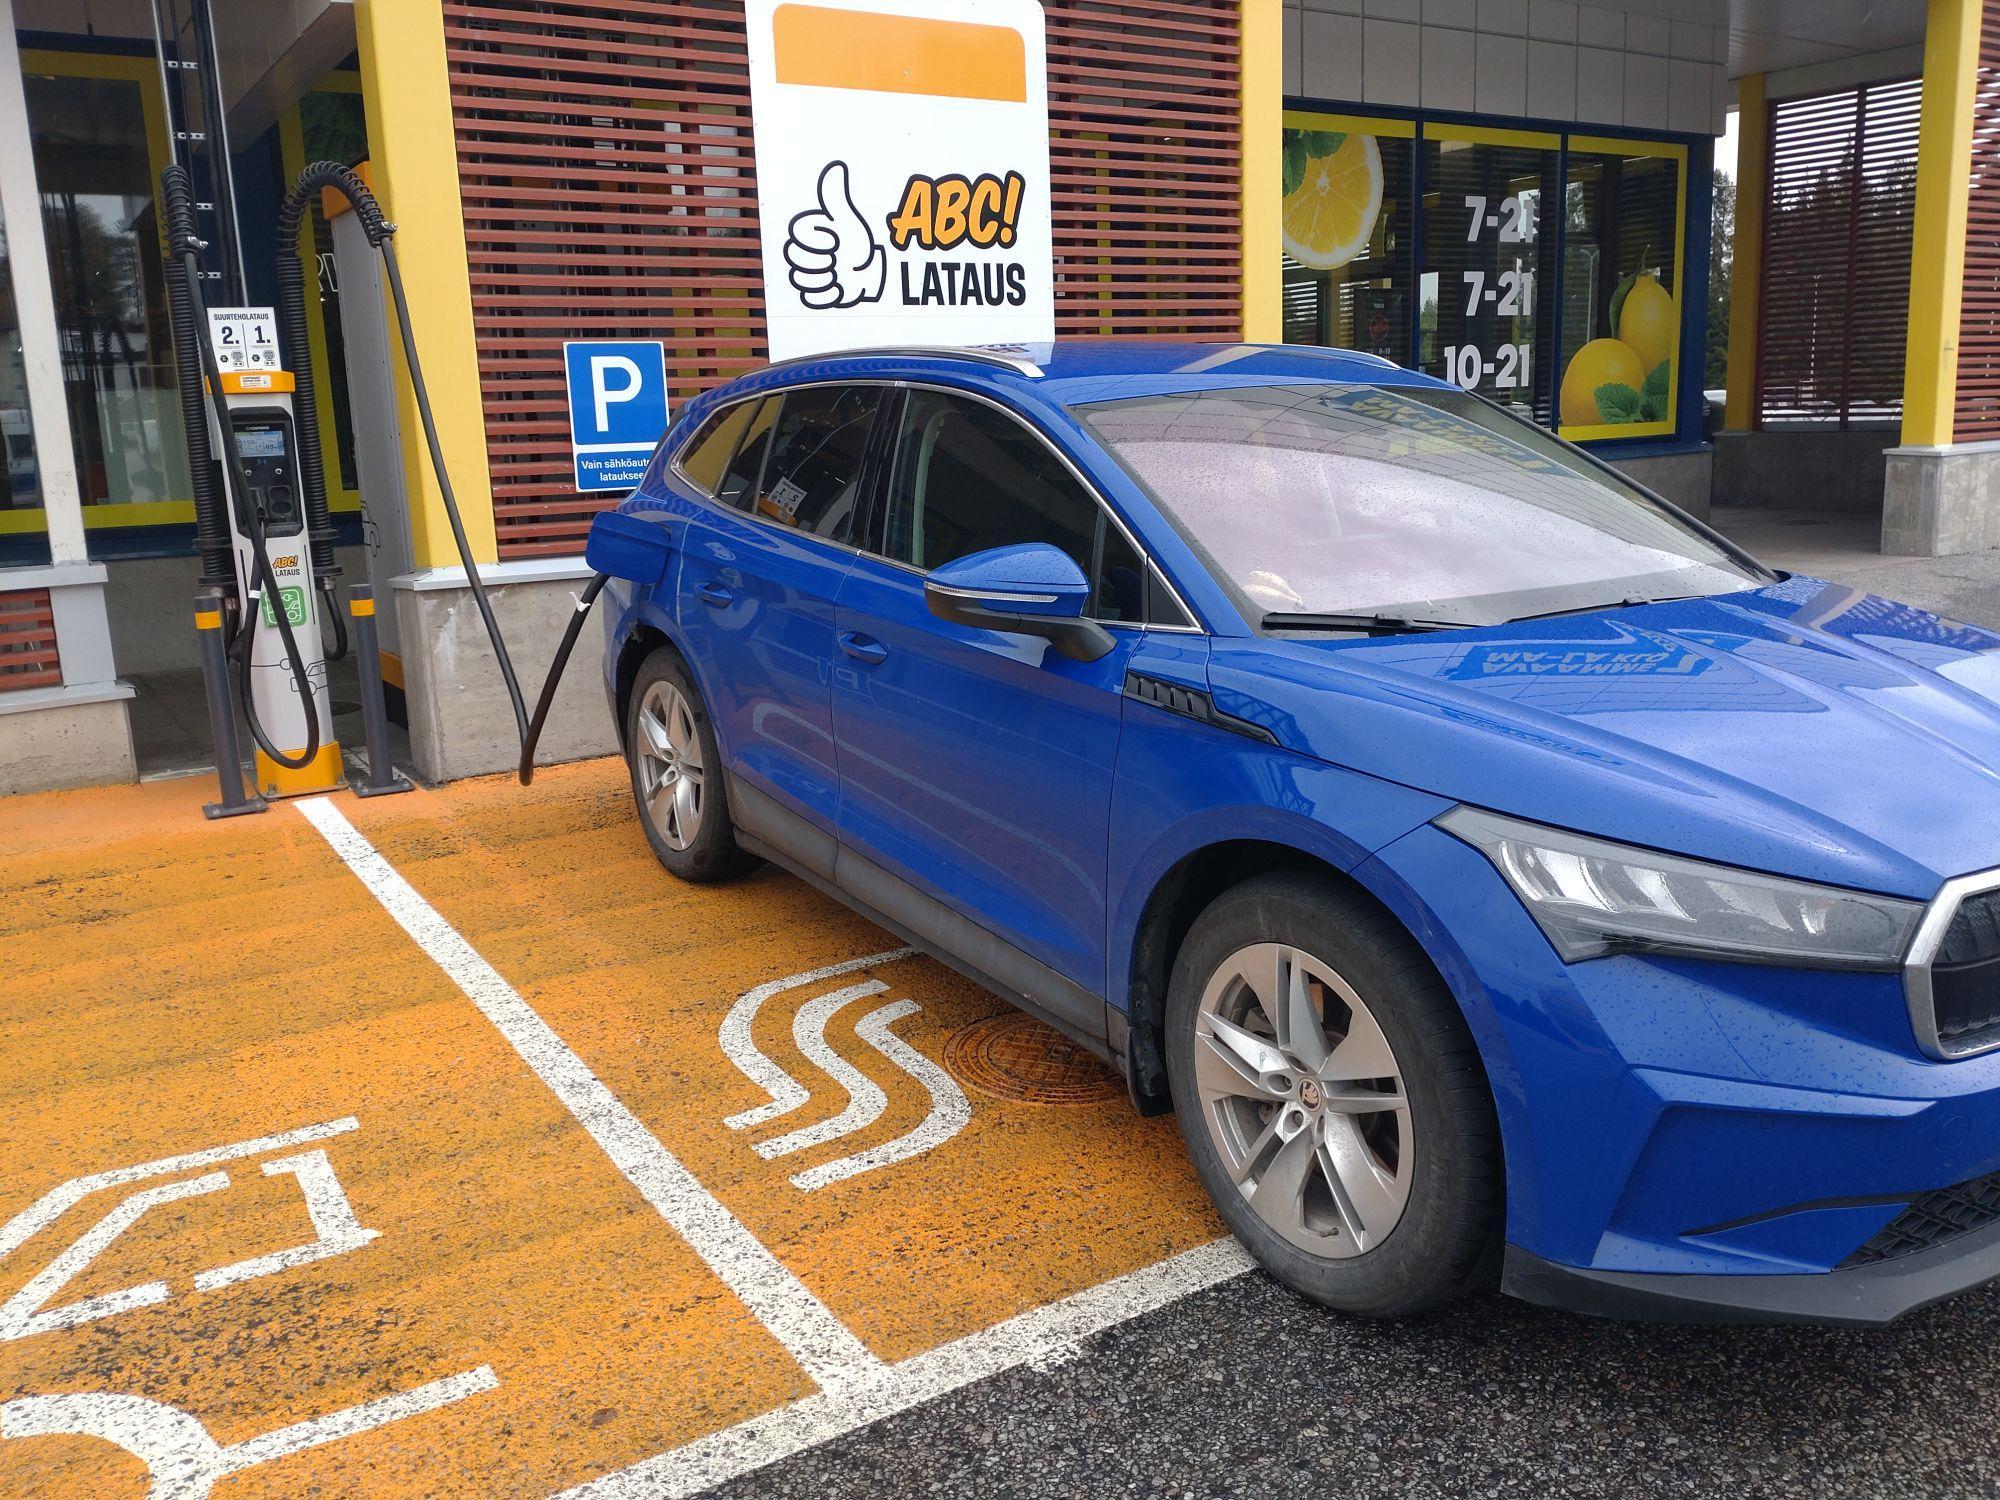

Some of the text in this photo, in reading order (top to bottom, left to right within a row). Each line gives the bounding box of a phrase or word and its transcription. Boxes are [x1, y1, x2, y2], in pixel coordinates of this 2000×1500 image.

[886, 169, 1026, 251] ABC!
[1465, 196, 1534, 243] 7-21
[900, 261, 1027, 307] LATAUS
[1463, 271, 1532, 317] 7-21
[213, 313, 270, 321] SUURTEHOLATAUS
[1444, 343, 1531, 391] 10-21
[590, 355, 643, 433] P
[581, 460, 603, 471] Vain
[272, 555, 299, 569] ABC!
[275, 569, 300, 577] LATAUS
